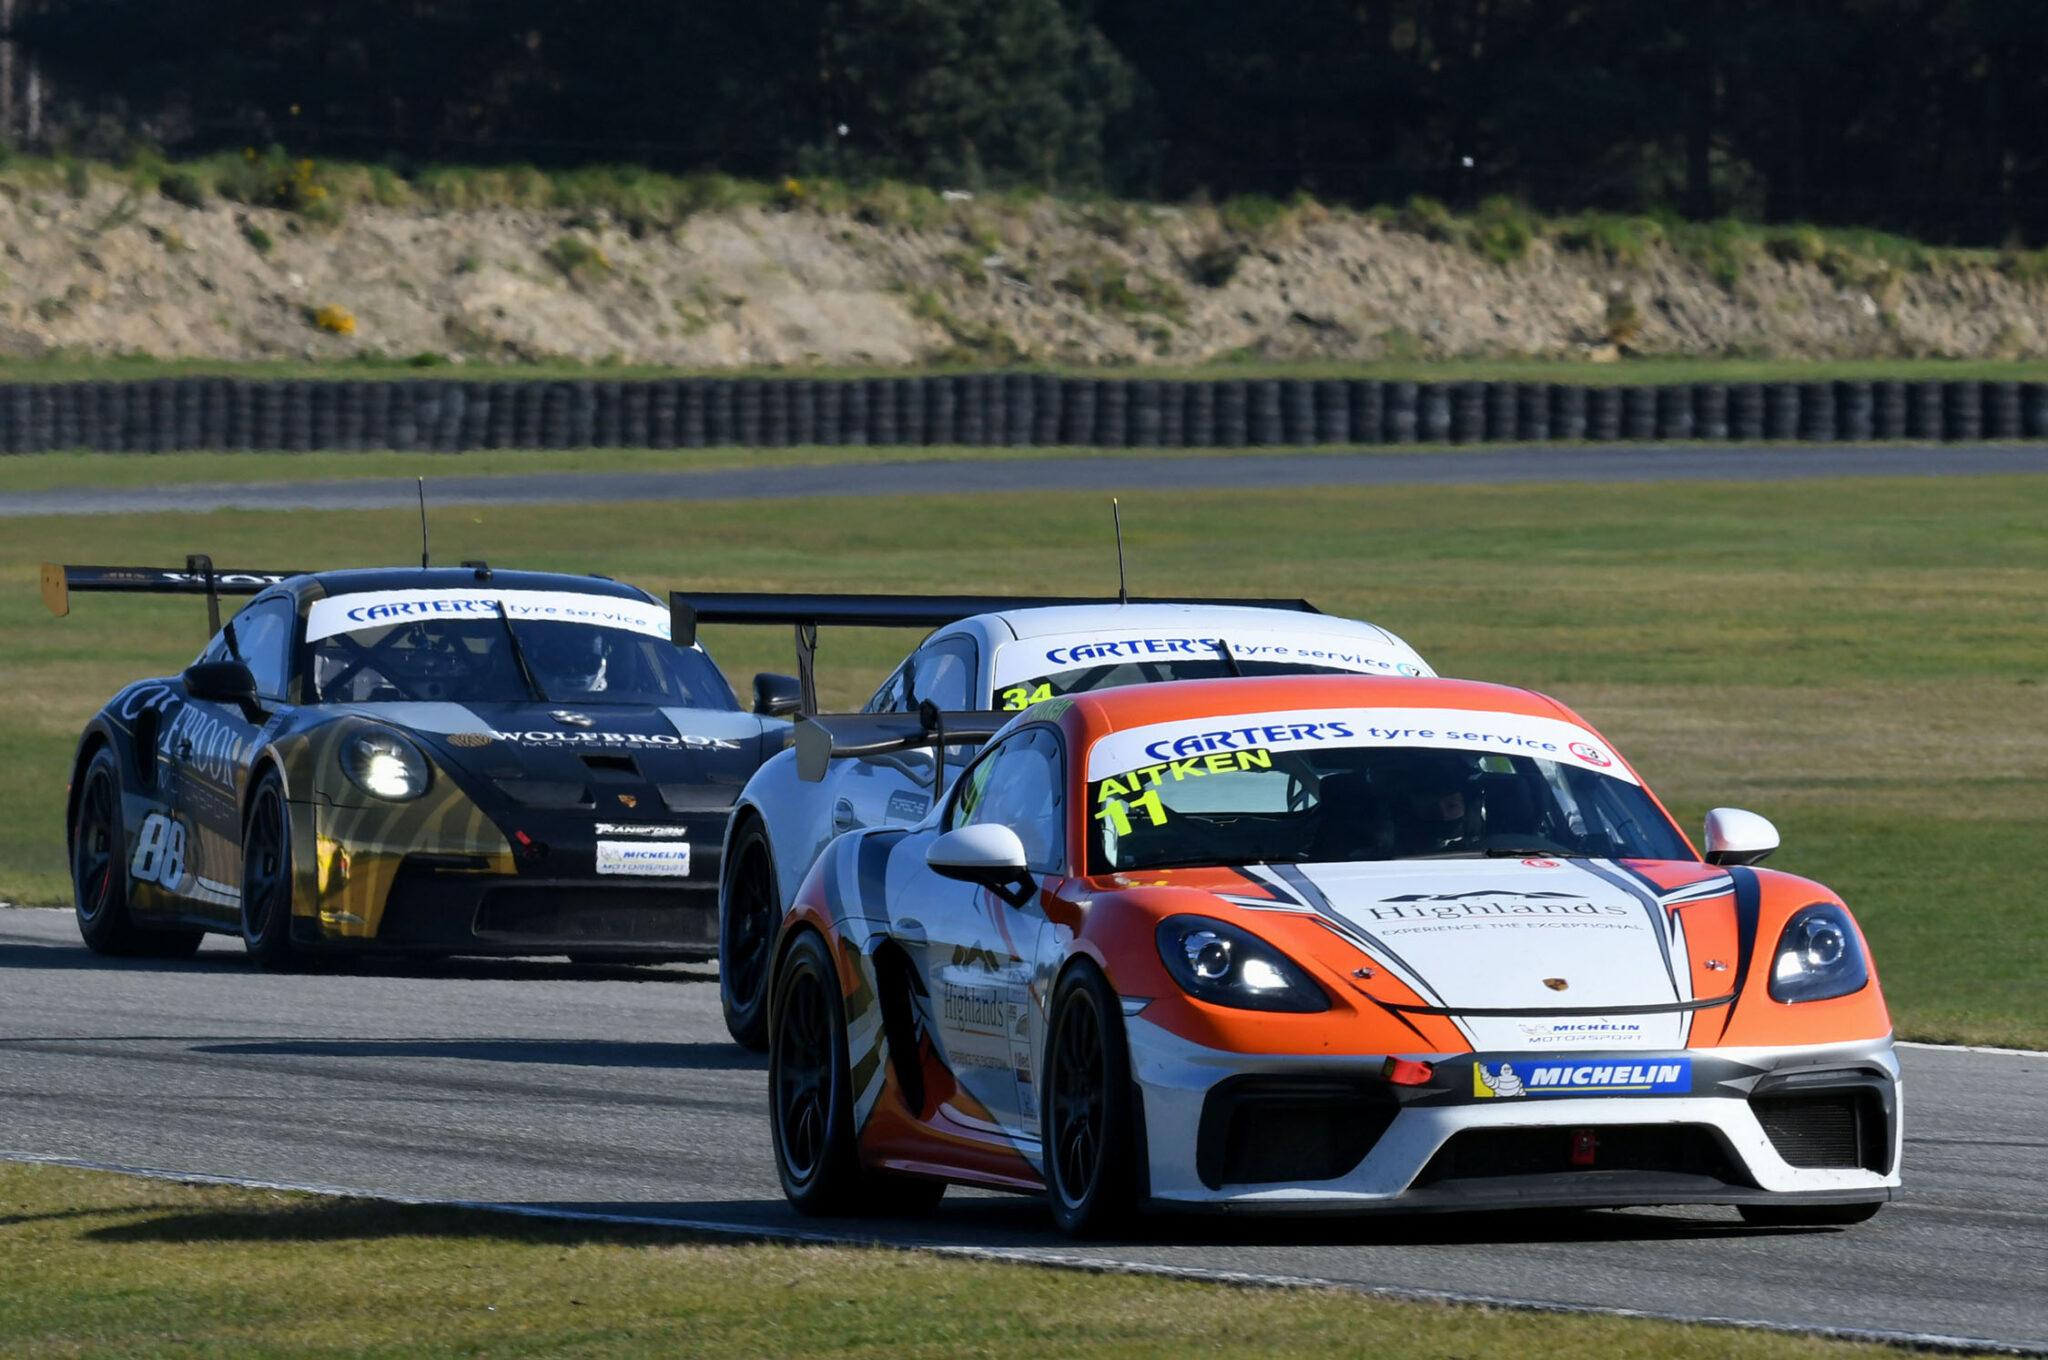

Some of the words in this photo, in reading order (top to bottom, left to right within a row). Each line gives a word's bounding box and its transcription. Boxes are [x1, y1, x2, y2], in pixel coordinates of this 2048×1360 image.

[346, 599, 500, 622] CARTER'S
[509, 603, 558, 615] tyre
[565, 608, 649, 626] service
[1046, 637, 1220, 664] CARTER'S
[1234, 643, 1289, 656] tyre
[1298, 649, 1392, 671] service
[1002, 682, 1057, 712] 34
[1145, 722, 1355, 761] CARTER'S
[1368, 727, 1435, 739] tyre
[1446, 730, 1558, 752] service
[1097, 749, 1272, 804] AITKEN
[1094, 789, 1167, 837] 11
[131, 814, 186, 889] 88
[623, 851, 686, 859] MICHELIN
[1368, 903, 1628, 919] Highlands
[1381, 924, 1480, 936] EXPERIENCE
[1528, 922, 1645, 930] EXCEPTIONAL
[945, 983, 1003, 1032] Highlands
[1528, 1034, 1641, 1043] MOTORSPORT
[1553, 1024, 1640, 1032] MICHELIN
[1530, 1065, 1681, 1086] MICHELIN
